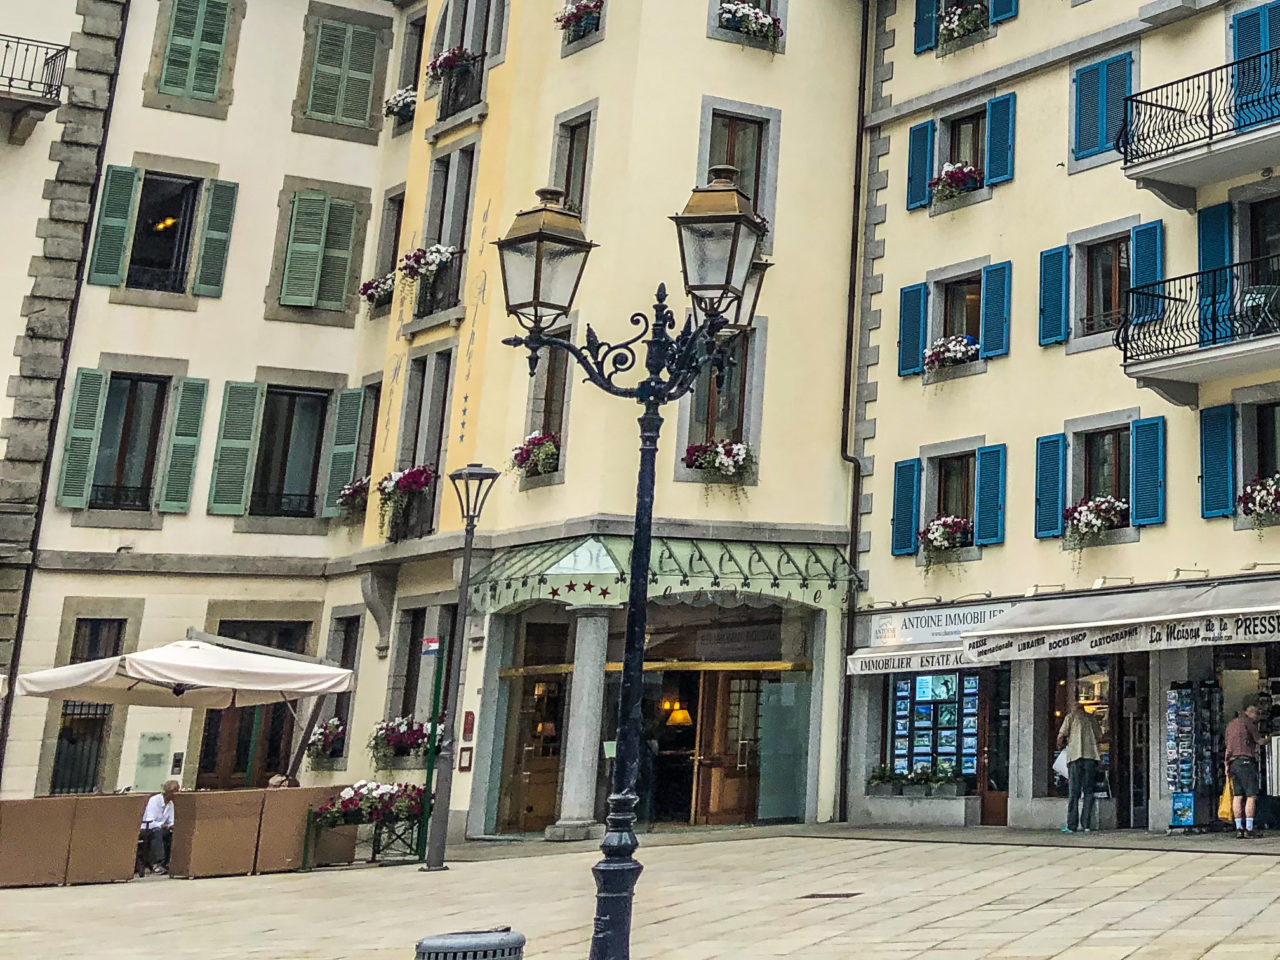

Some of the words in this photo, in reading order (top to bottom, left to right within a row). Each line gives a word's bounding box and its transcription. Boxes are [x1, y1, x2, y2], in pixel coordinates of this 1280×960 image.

[901, 614, 943, 630] ANTOINE
[1149, 626, 1162, 643] La
[1166, 624, 1201, 642] Maison
[1205, 618, 1216, 633] de
[1219, 617, 1228, 632] la
[968, 638, 987, 651] PRESSE
[1017, 637, 1046, 652] LIBRAIRIE
[1048, 637, 1070, 651] BOOKS
[1070, 632, 1087, 645] SHOP
[1090, 627, 1138, 649] CARTOGRAPHIE
[860, 657, 912, 671] IMMOBILIER
[920, 655, 951, 668] ESTATE
